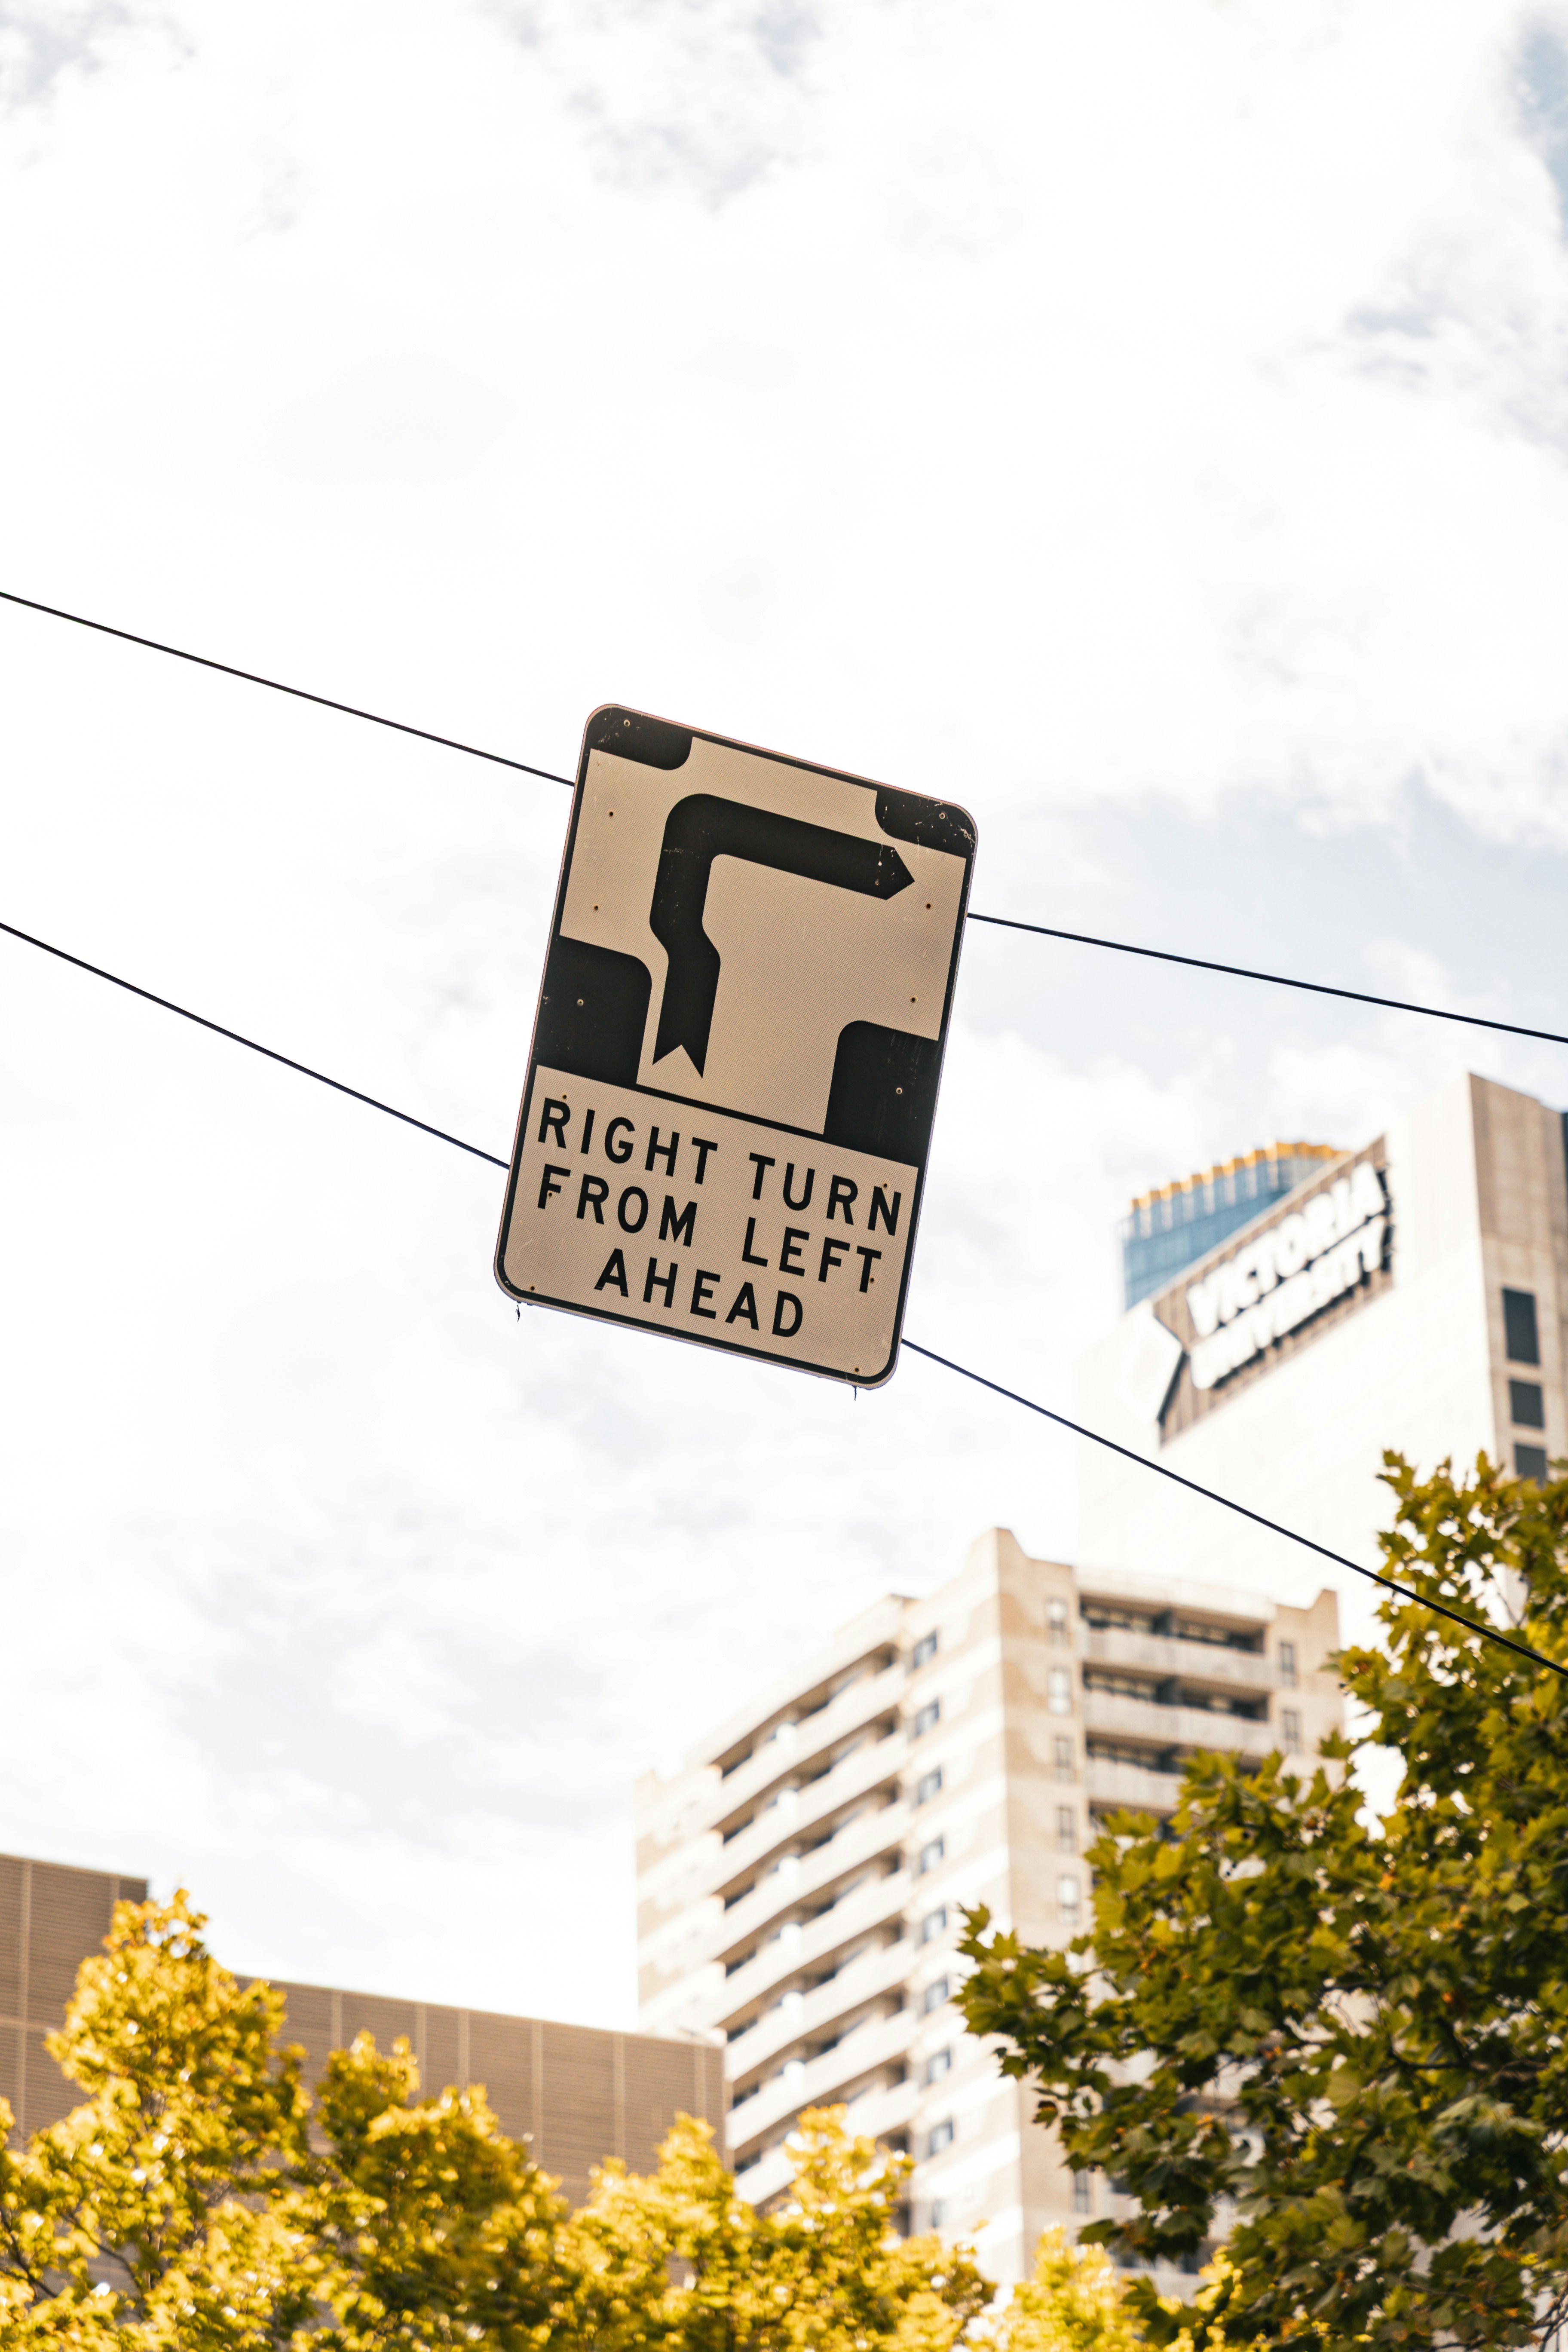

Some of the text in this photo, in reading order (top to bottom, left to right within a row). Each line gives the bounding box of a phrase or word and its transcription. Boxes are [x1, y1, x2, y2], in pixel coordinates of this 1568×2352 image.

[537, 1163, 882, 1293] FROM LEFT
[538, 1097, 902, 1237] RIGHT TURN
[594, 1248, 803, 1338] AHEAD
[1186, 1161, 1385, 1337] VICTORIA
